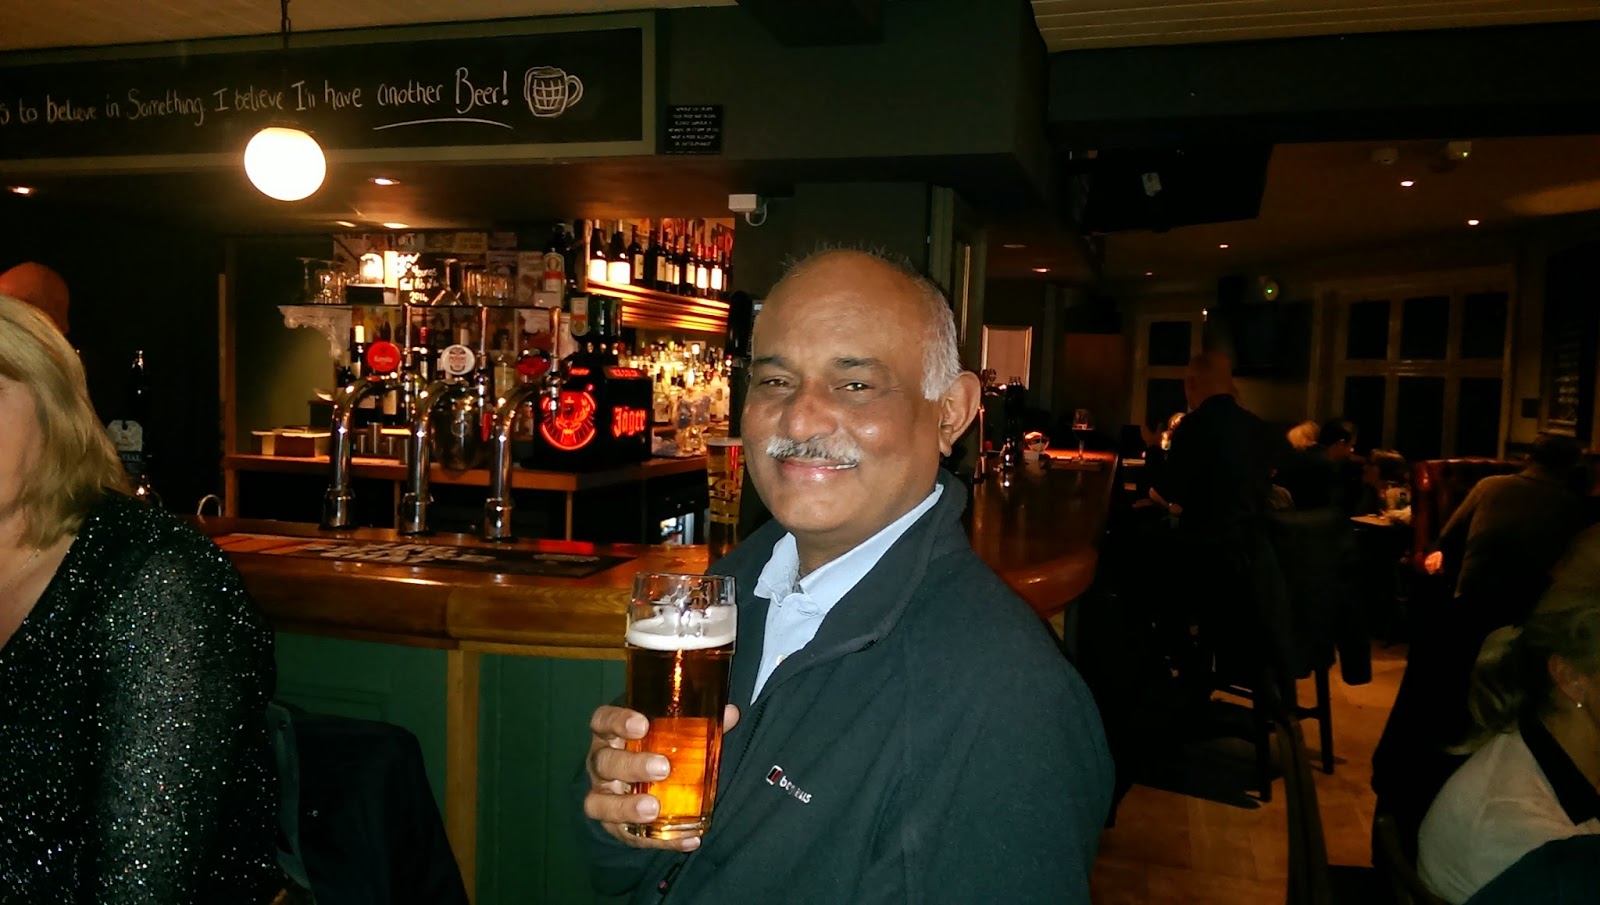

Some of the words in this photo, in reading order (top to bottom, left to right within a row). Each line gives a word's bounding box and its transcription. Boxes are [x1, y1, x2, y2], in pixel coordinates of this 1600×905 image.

[19, 98, 38, 124] to
[46, 94, 97, 124] believe
[105, 93, 120, 118] in
[212, 87, 229, 112] I
[234, 86, 284, 111] believe
[324, 79, 363, 110] have
[377, 80, 443, 106] another
[455, 66, 509, 114] Beer!
[779, 775, 812, 804] behaus
